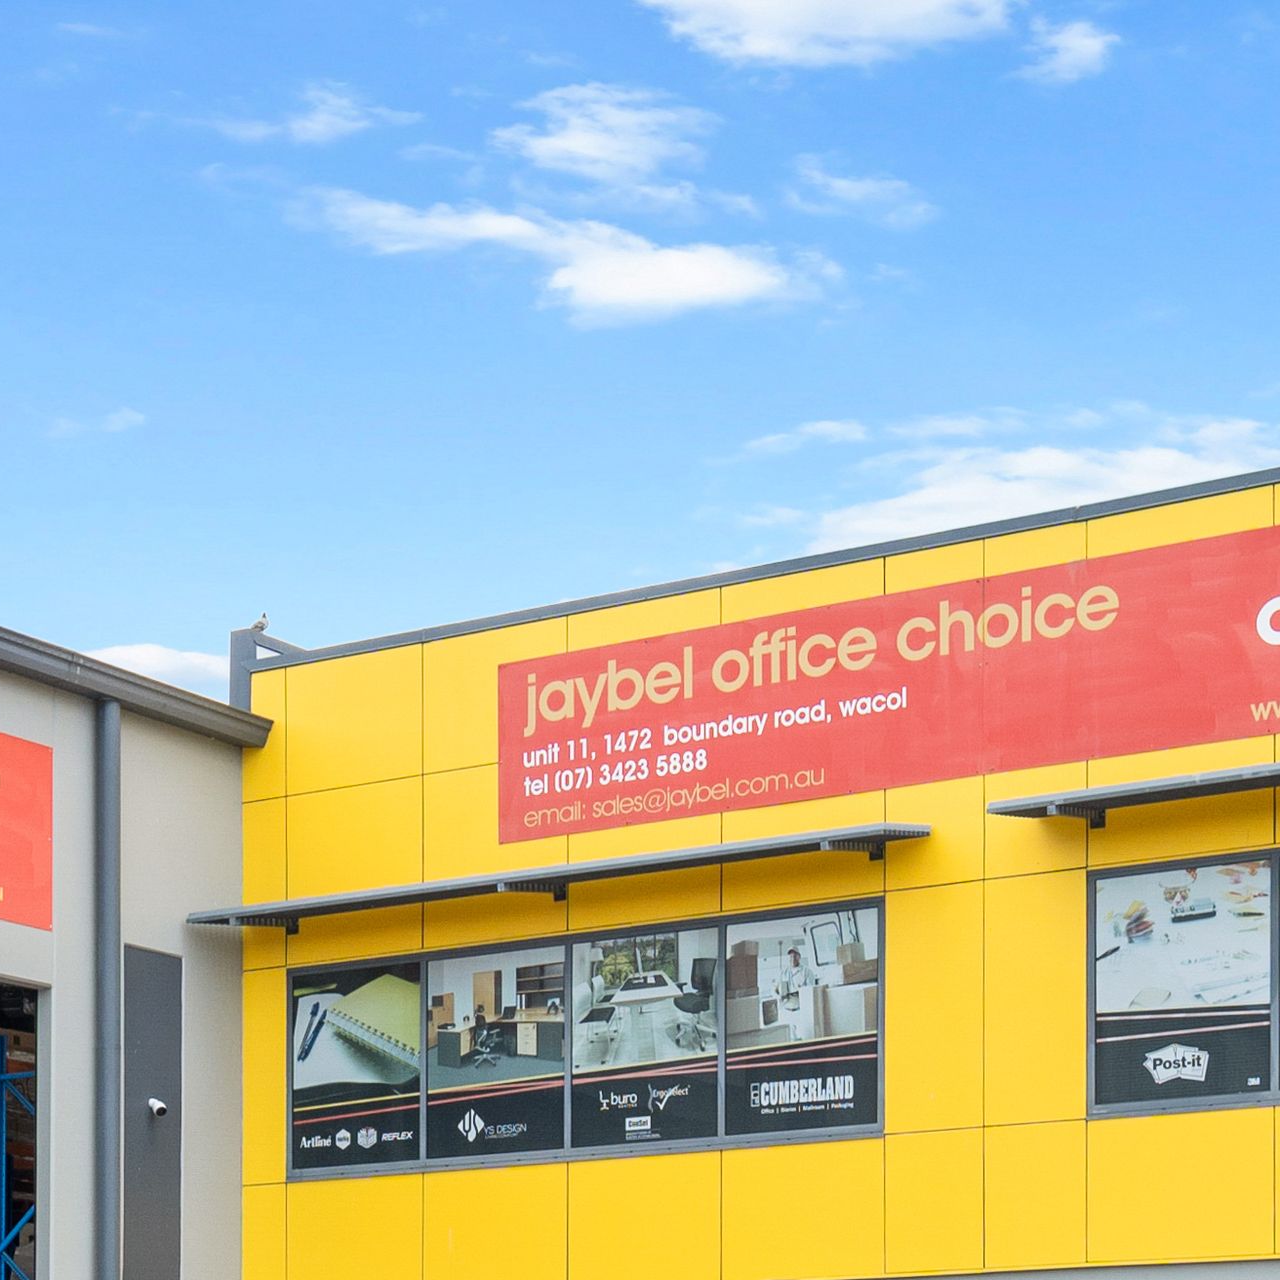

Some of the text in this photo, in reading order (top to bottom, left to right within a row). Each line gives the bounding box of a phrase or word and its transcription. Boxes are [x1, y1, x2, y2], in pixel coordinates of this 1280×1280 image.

[524, 584, 1120, 737] jaybel office choice
[523, 687, 908, 769] unit 11, 1472 boundary road, wacol
[523, 748, 708, 797] tel (07) 3423 5888
[523, 765, 826, 830] email: sales@jaybel.com.au
[1152, 1054, 1202, 1072] Post-it
[611, 1091, 638, 1105] buro
[761, 1075, 854, 1106] CUMBERLAND
[381, 1131, 414, 1142] REFLEX
[496, 1123, 527, 1135] DESIGN
